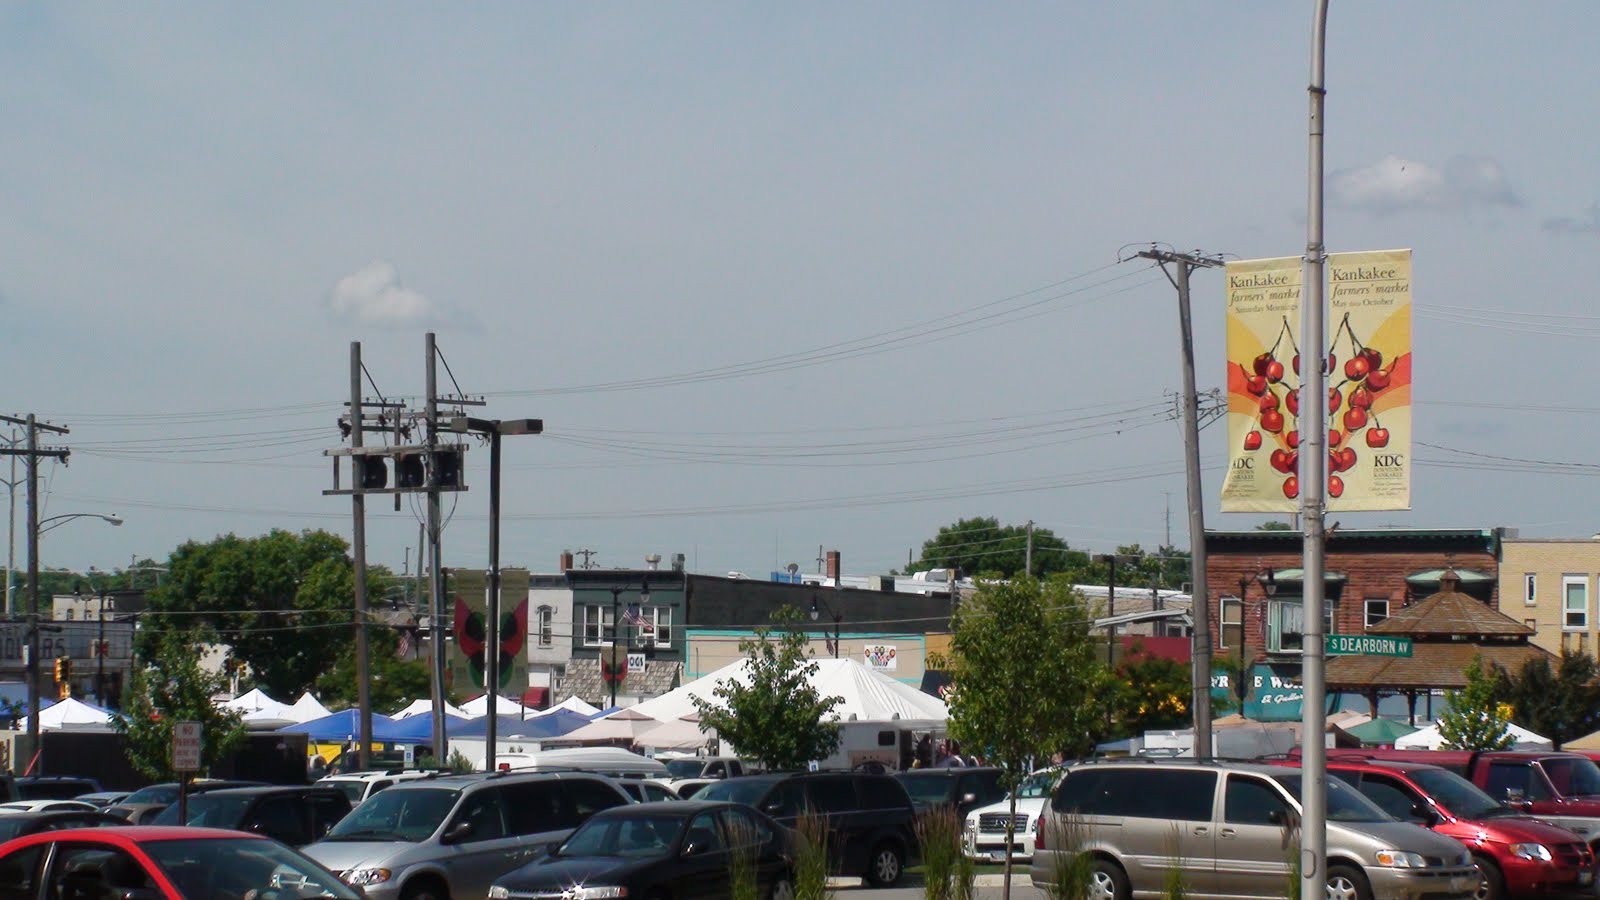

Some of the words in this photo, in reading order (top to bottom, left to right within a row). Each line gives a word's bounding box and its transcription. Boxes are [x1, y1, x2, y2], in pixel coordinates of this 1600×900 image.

[1333, 267, 1395, 281] Kankakee
[1230, 274, 1288, 288] Kankakee
[1376, 282, 1408, 293] market
[1270, 289, 1300, 300] market
[1333, 300, 1346, 308] May
[1374, 456, 1403, 467] KDC
[1332, 639, 1338, 649] S
[1340, 638, 1396, 653] DEARBORN
[1398, 642, 1408, 653] AV
[183, 725, 194, 735] NO
[176, 737, 200, 746] PARKING
